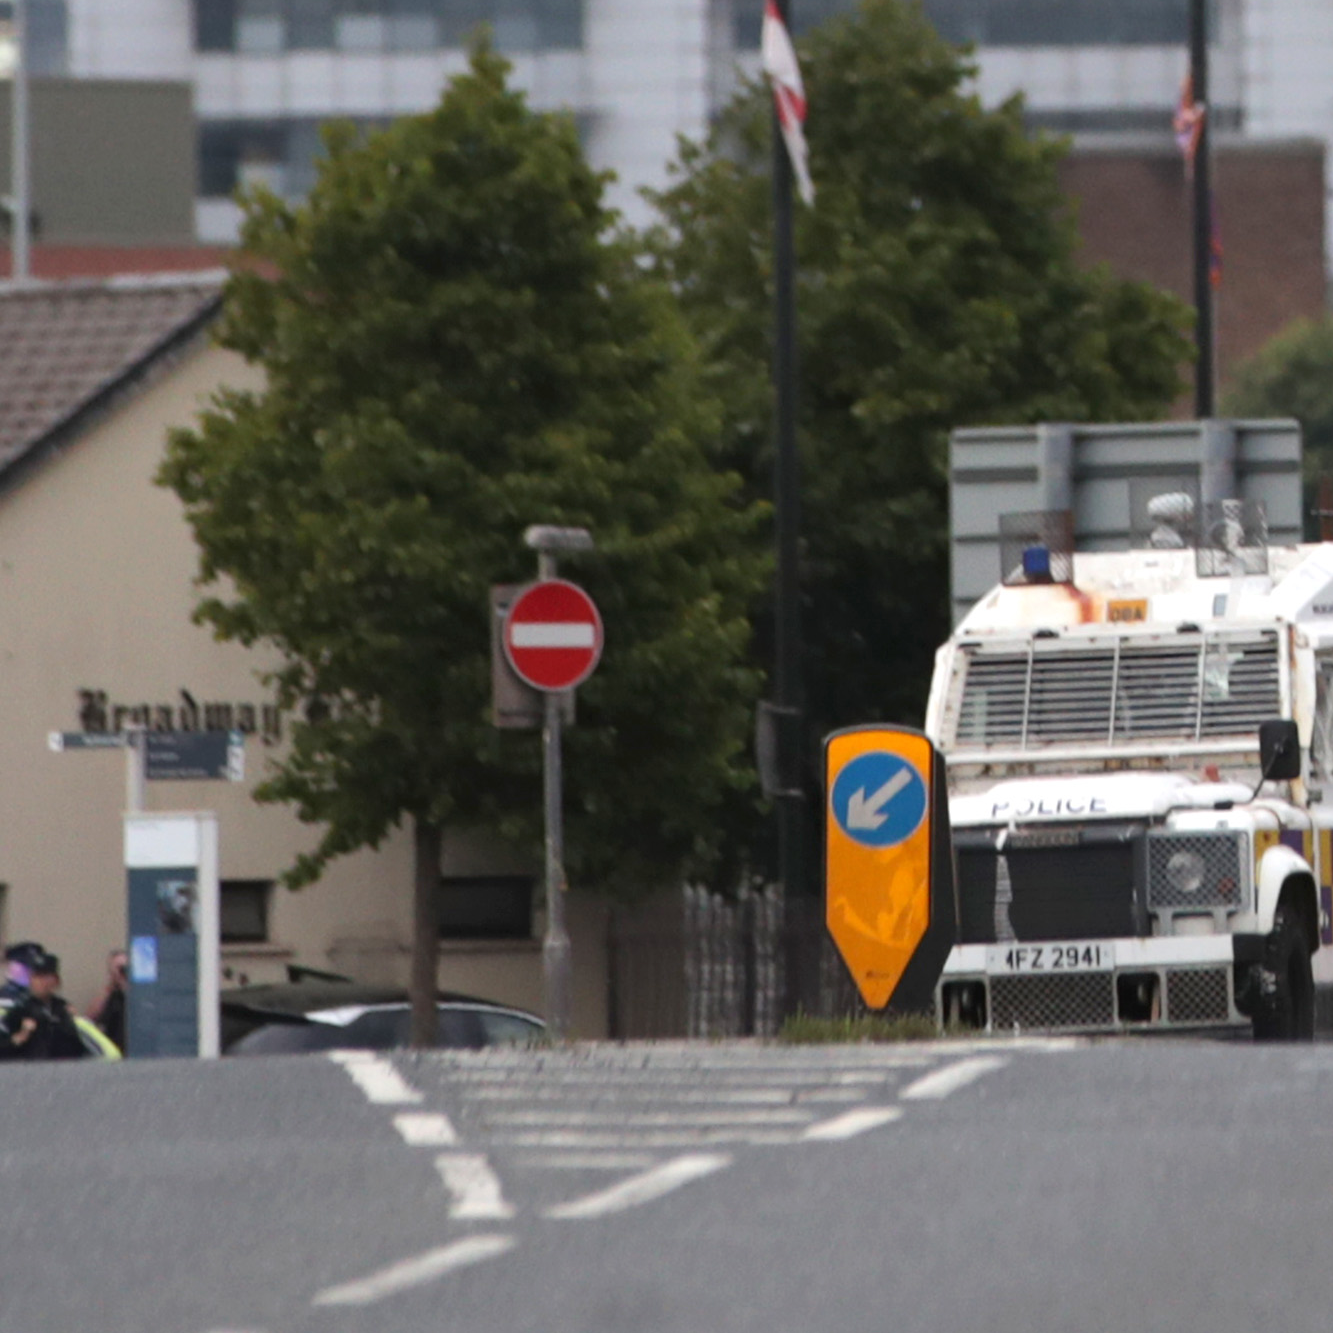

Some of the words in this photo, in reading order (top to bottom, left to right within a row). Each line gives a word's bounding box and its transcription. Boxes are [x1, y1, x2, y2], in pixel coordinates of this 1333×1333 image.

[78, 688, 281, 747] Broadway
[991, 797, 1106, 819] POLICE
[1052, 945, 1100, 968] 2941
